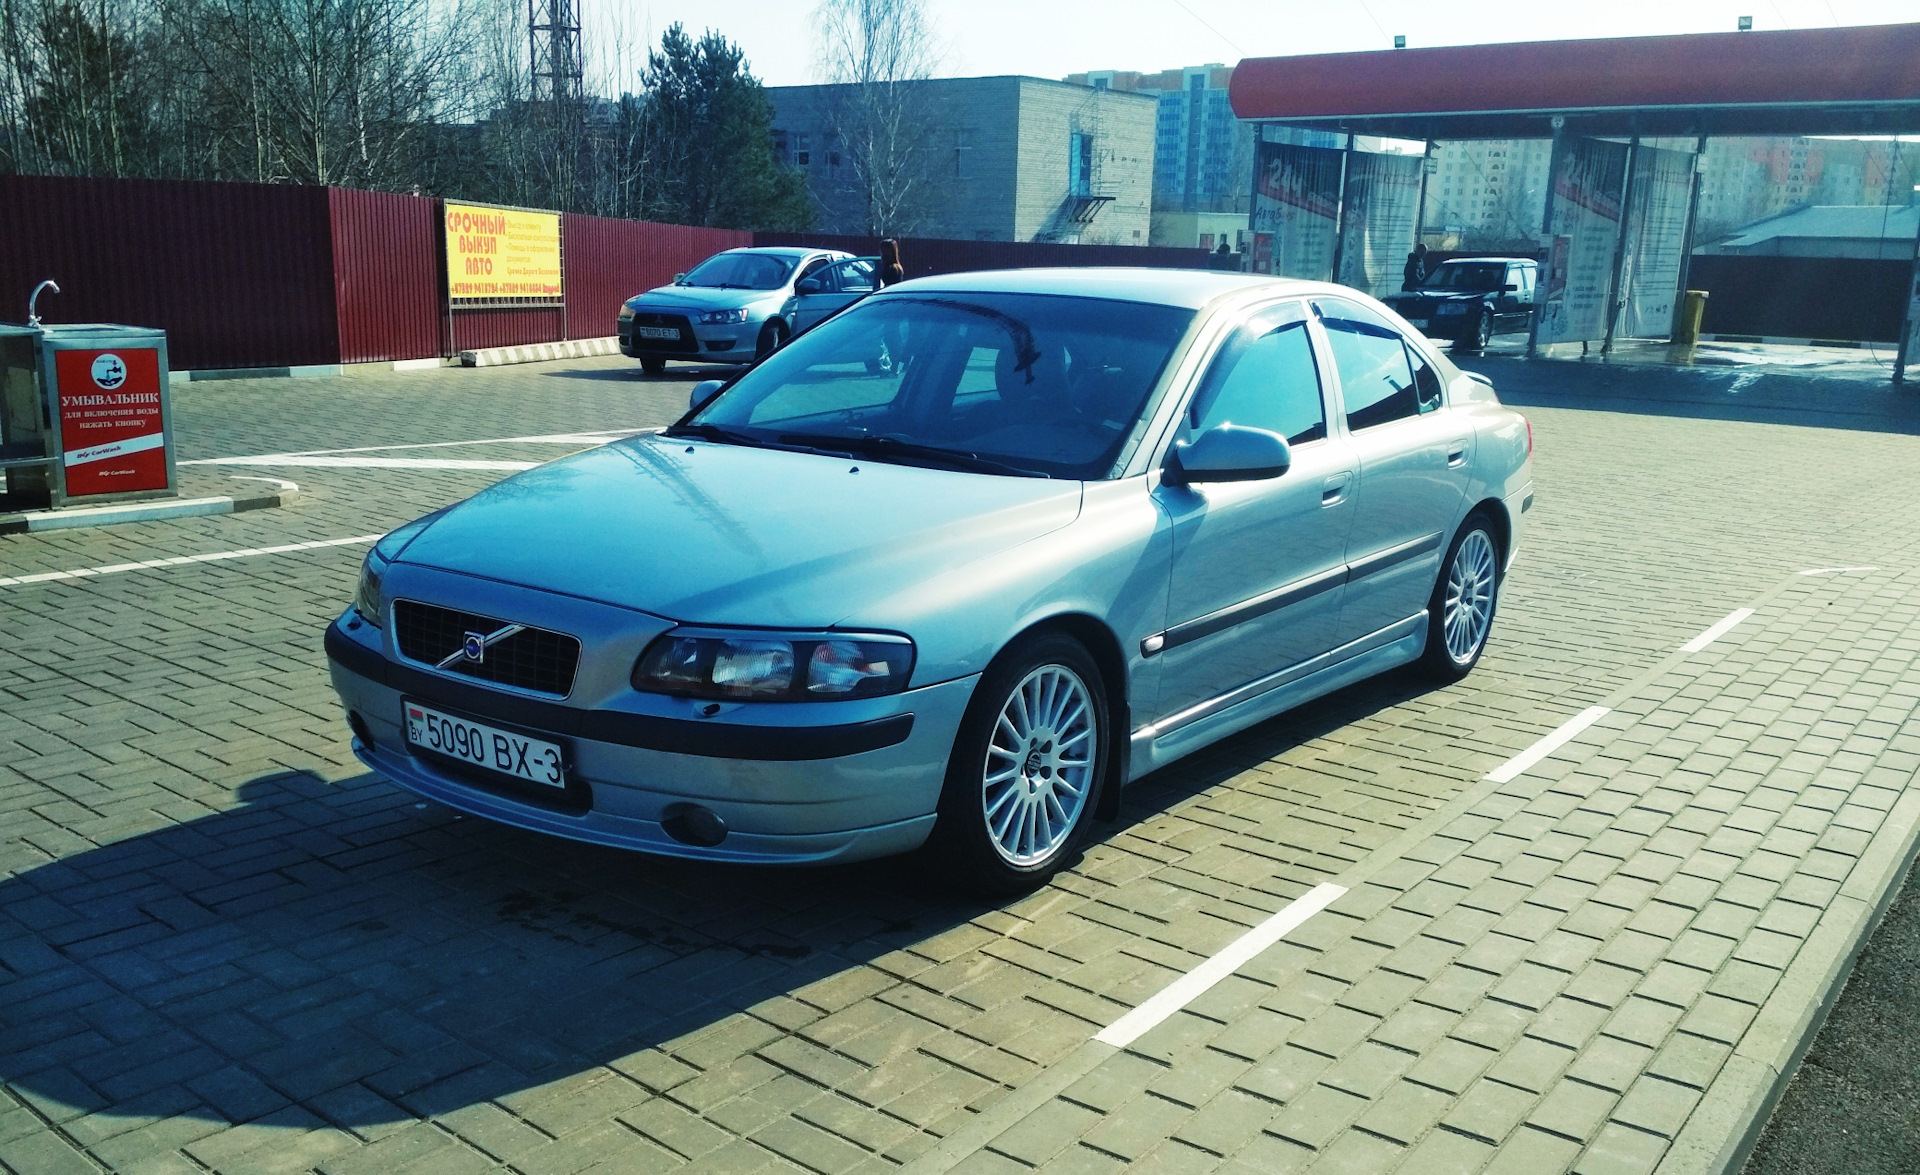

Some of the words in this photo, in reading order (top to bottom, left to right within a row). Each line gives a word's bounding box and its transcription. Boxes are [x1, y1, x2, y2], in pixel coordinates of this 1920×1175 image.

[447, 211, 506, 235] СРОЧНЫЙ
[459, 234, 497, 255] ВЫКУП
[465, 256, 493, 276] АВТО
[61, 393, 159, 407] УМЫВАЛЬНИК
[64, 411, 81, 419] для
[84, 409, 133, 418] включения
[79, 421, 112, 429] нажать
[115, 419, 147, 428] кнопку
[411, 726, 423, 743] BY
[426, 713, 485, 763] 5090
[492, 733, 562, 784] BX-3
